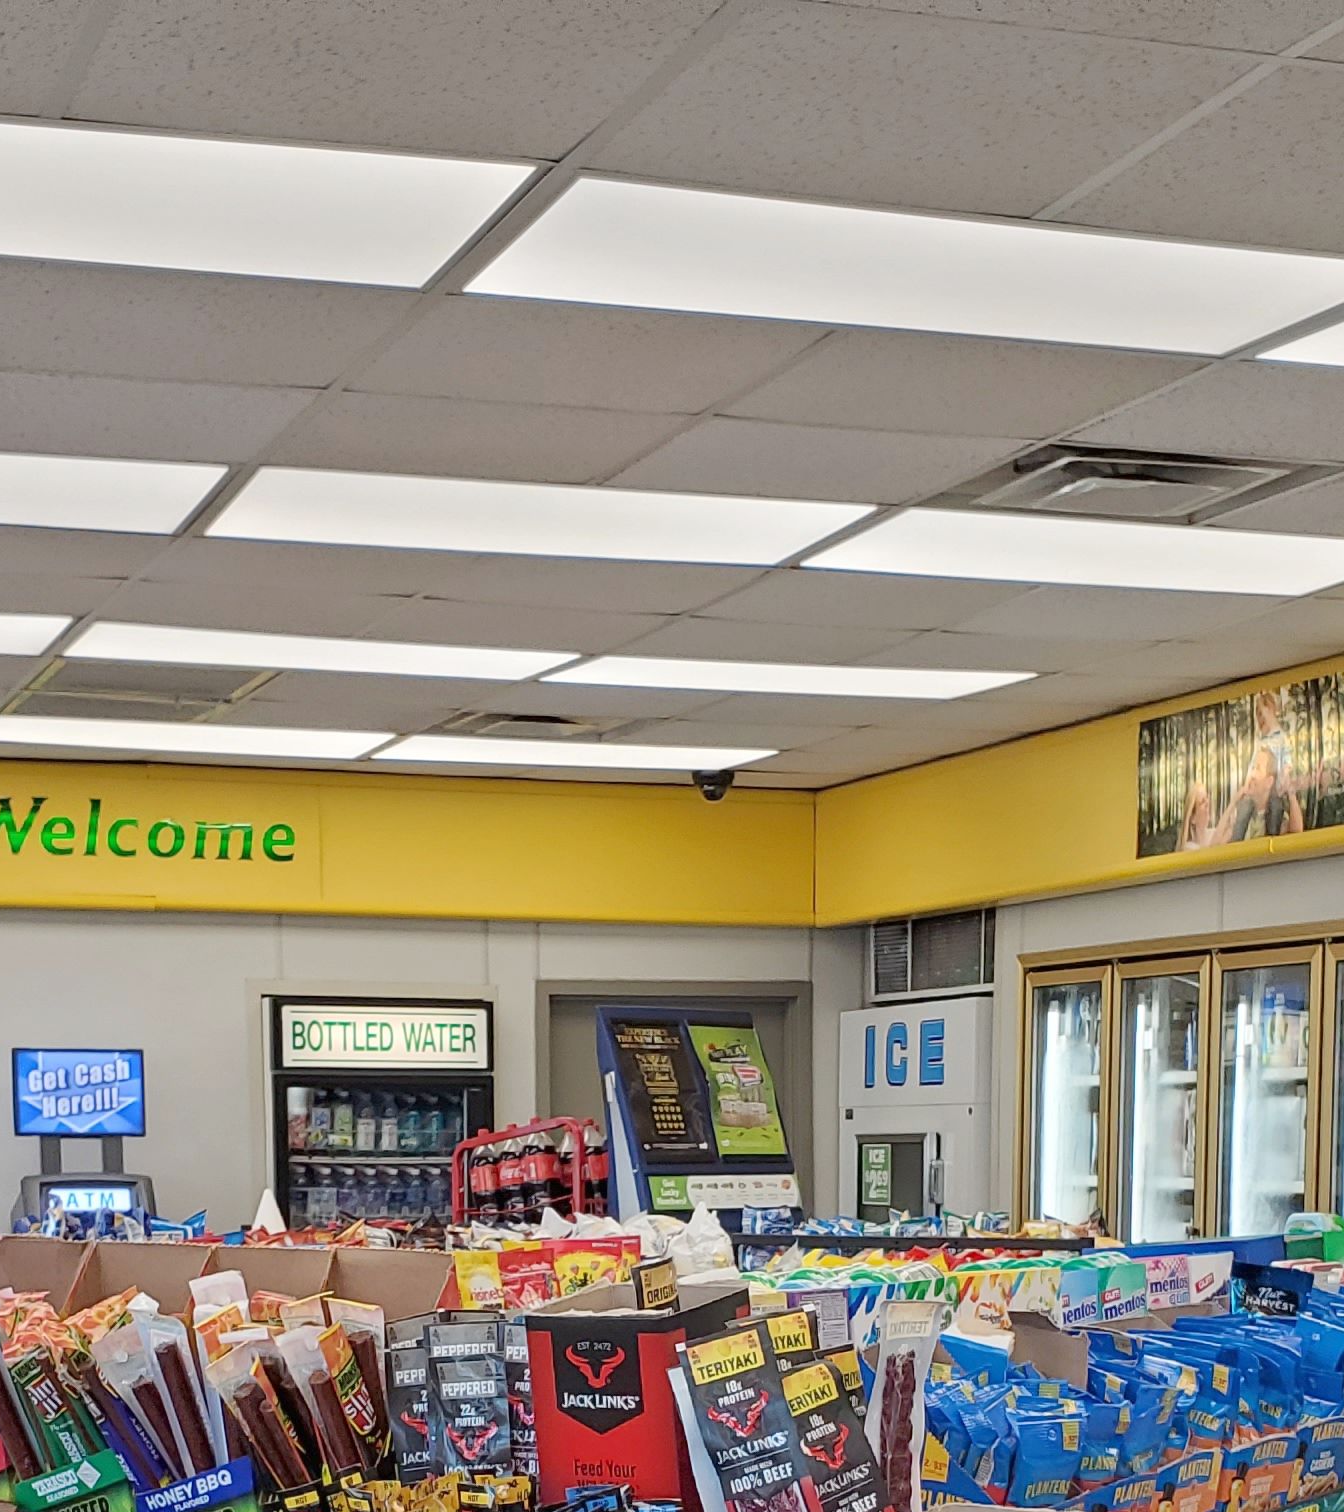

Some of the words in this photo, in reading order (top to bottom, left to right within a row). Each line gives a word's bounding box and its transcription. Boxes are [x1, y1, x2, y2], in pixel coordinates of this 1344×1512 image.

[292, 1020, 394, 1051] BOTTLED
[402, 1023, 476, 1053] WATER
[864, 1019, 945, 1088] ICE
[28, 1068, 68, 1093] Get
[75, 1059, 131, 1086] Cash
[41, 1087, 120, 1118] Here!!!
[66, 1193, 114, 1208] ATM
[1150, 1276, 1188, 1293] mentos
[697, 1352, 758, 1380] TERIYAKI
[442, 1380, 495, 1396] PEPPERED
[718, 1388, 755, 1408] PROTEIN
[788, 1383, 833, 1413] ERIYAKI
[455, 1417, 485, 1428] PROTEIN
[574, 1458, 603, 1477] Feed
[606, 1459, 637, 1478] Your
[730, 1468, 762, 1494] 100%
[763, 1462, 794, 1485] BEEF
[145, 1484, 193, 1511] HONEY
[197, 1470, 233, 1495] BBQ
[174, 1495, 210, 1512] FLAVORED
